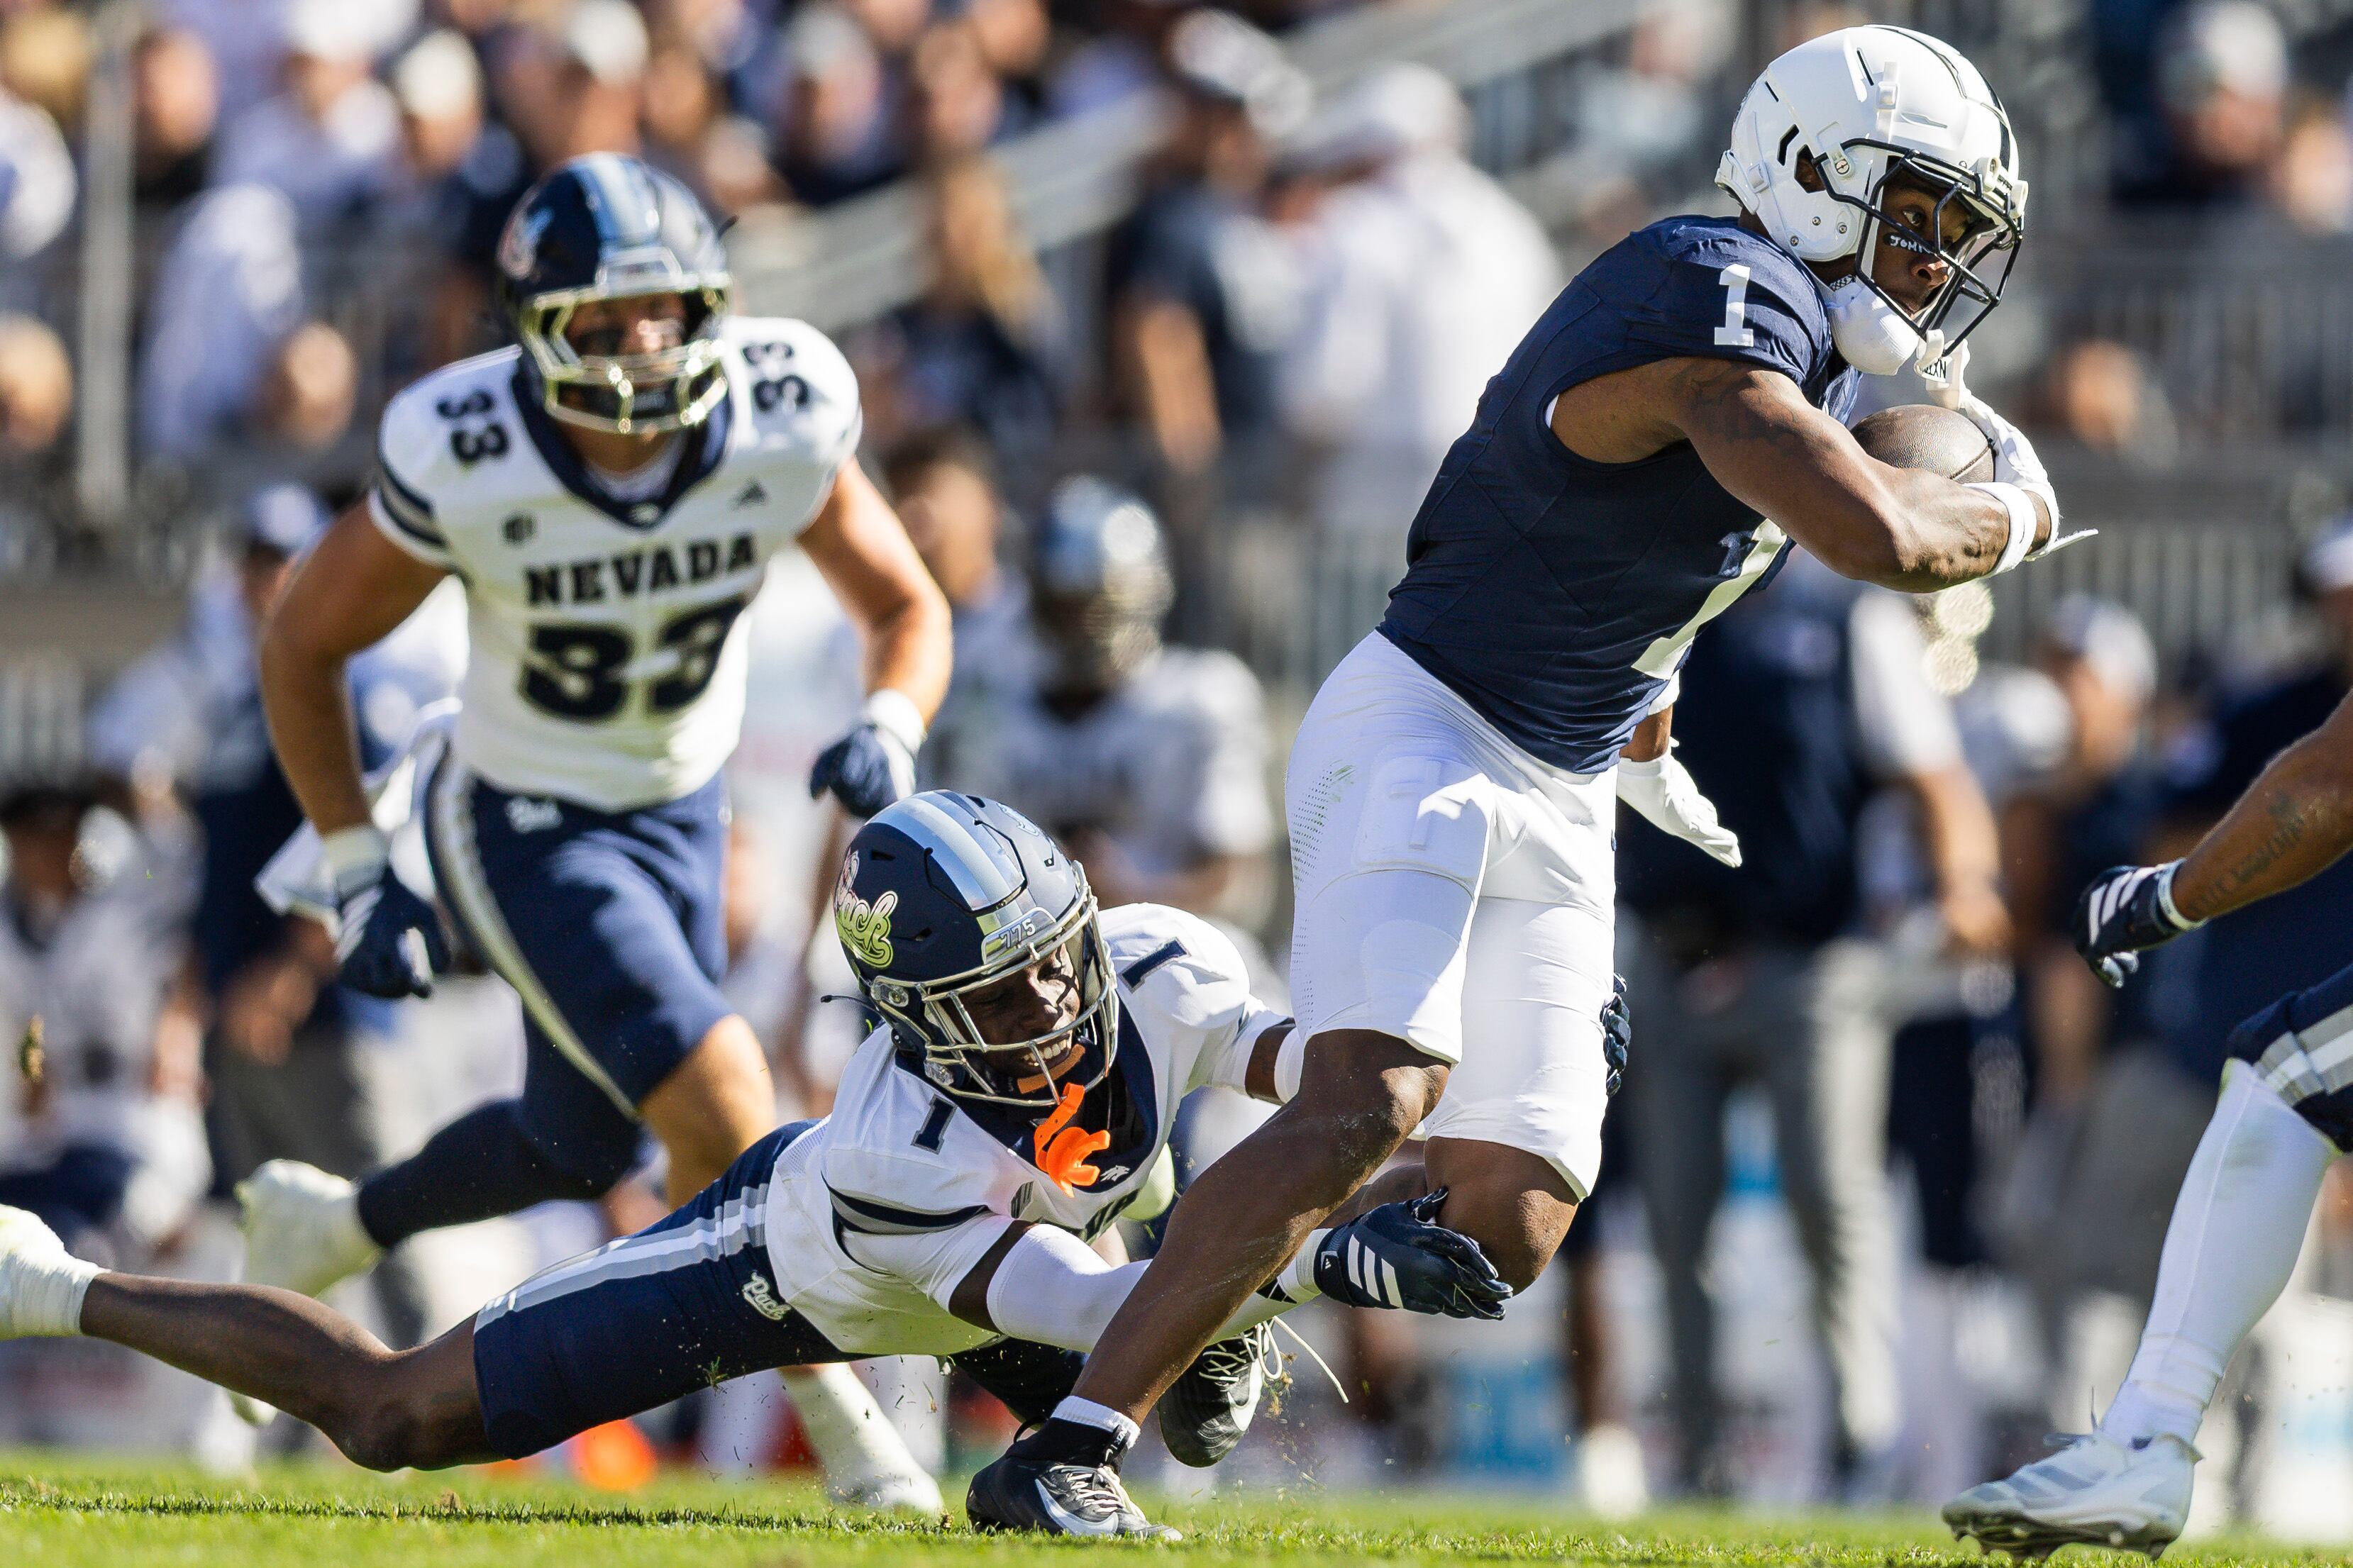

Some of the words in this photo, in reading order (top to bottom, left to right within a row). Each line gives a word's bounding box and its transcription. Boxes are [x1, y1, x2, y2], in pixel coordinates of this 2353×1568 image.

[1714, 264, 1754, 347] 1
[741, 342, 809, 411] 33
[436, 389, 509, 465] 33
[526, 531, 755, 603] NEVADA
[520, 594, 748, 716] 33
[1000, 918, 1036, 948] 775
[1119, 937, 1191, 993] 1
[910, 1096, 957, 1154] 1
